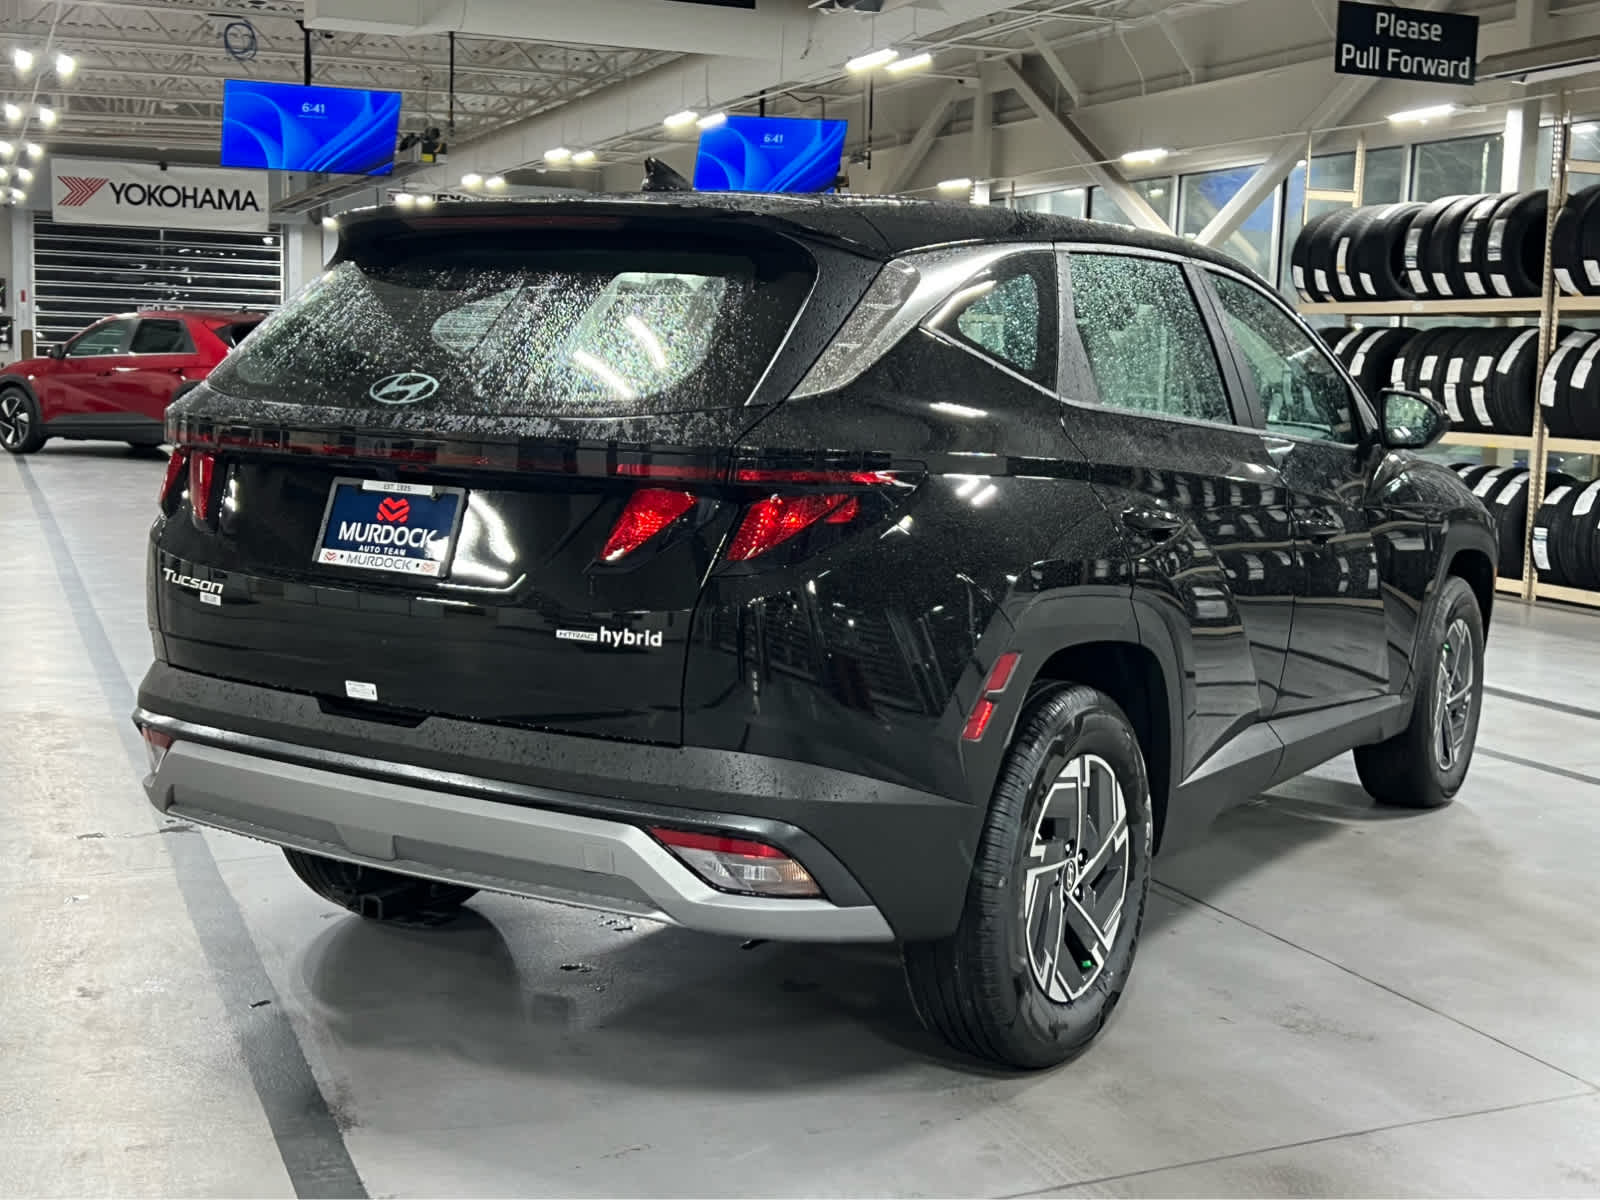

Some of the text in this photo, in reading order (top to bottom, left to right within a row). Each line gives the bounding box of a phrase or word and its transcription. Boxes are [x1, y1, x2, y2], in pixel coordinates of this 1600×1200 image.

[1375, 11, 1442, 41] Please
[1341, 43, 1471, 79] Pull Forward
[301, 102, 326, 114] 6:41
[763, 133, 784, 144] 6:41
[109, 182, 260, 212] YOKOHAMA
[338, 521, 438, 548] MURDOCK
[358, 544, 407, 556] AUTO TEAM
[345, 553, 412, 571] MURDOCK
[600, 625, 663, 648] hybrid
